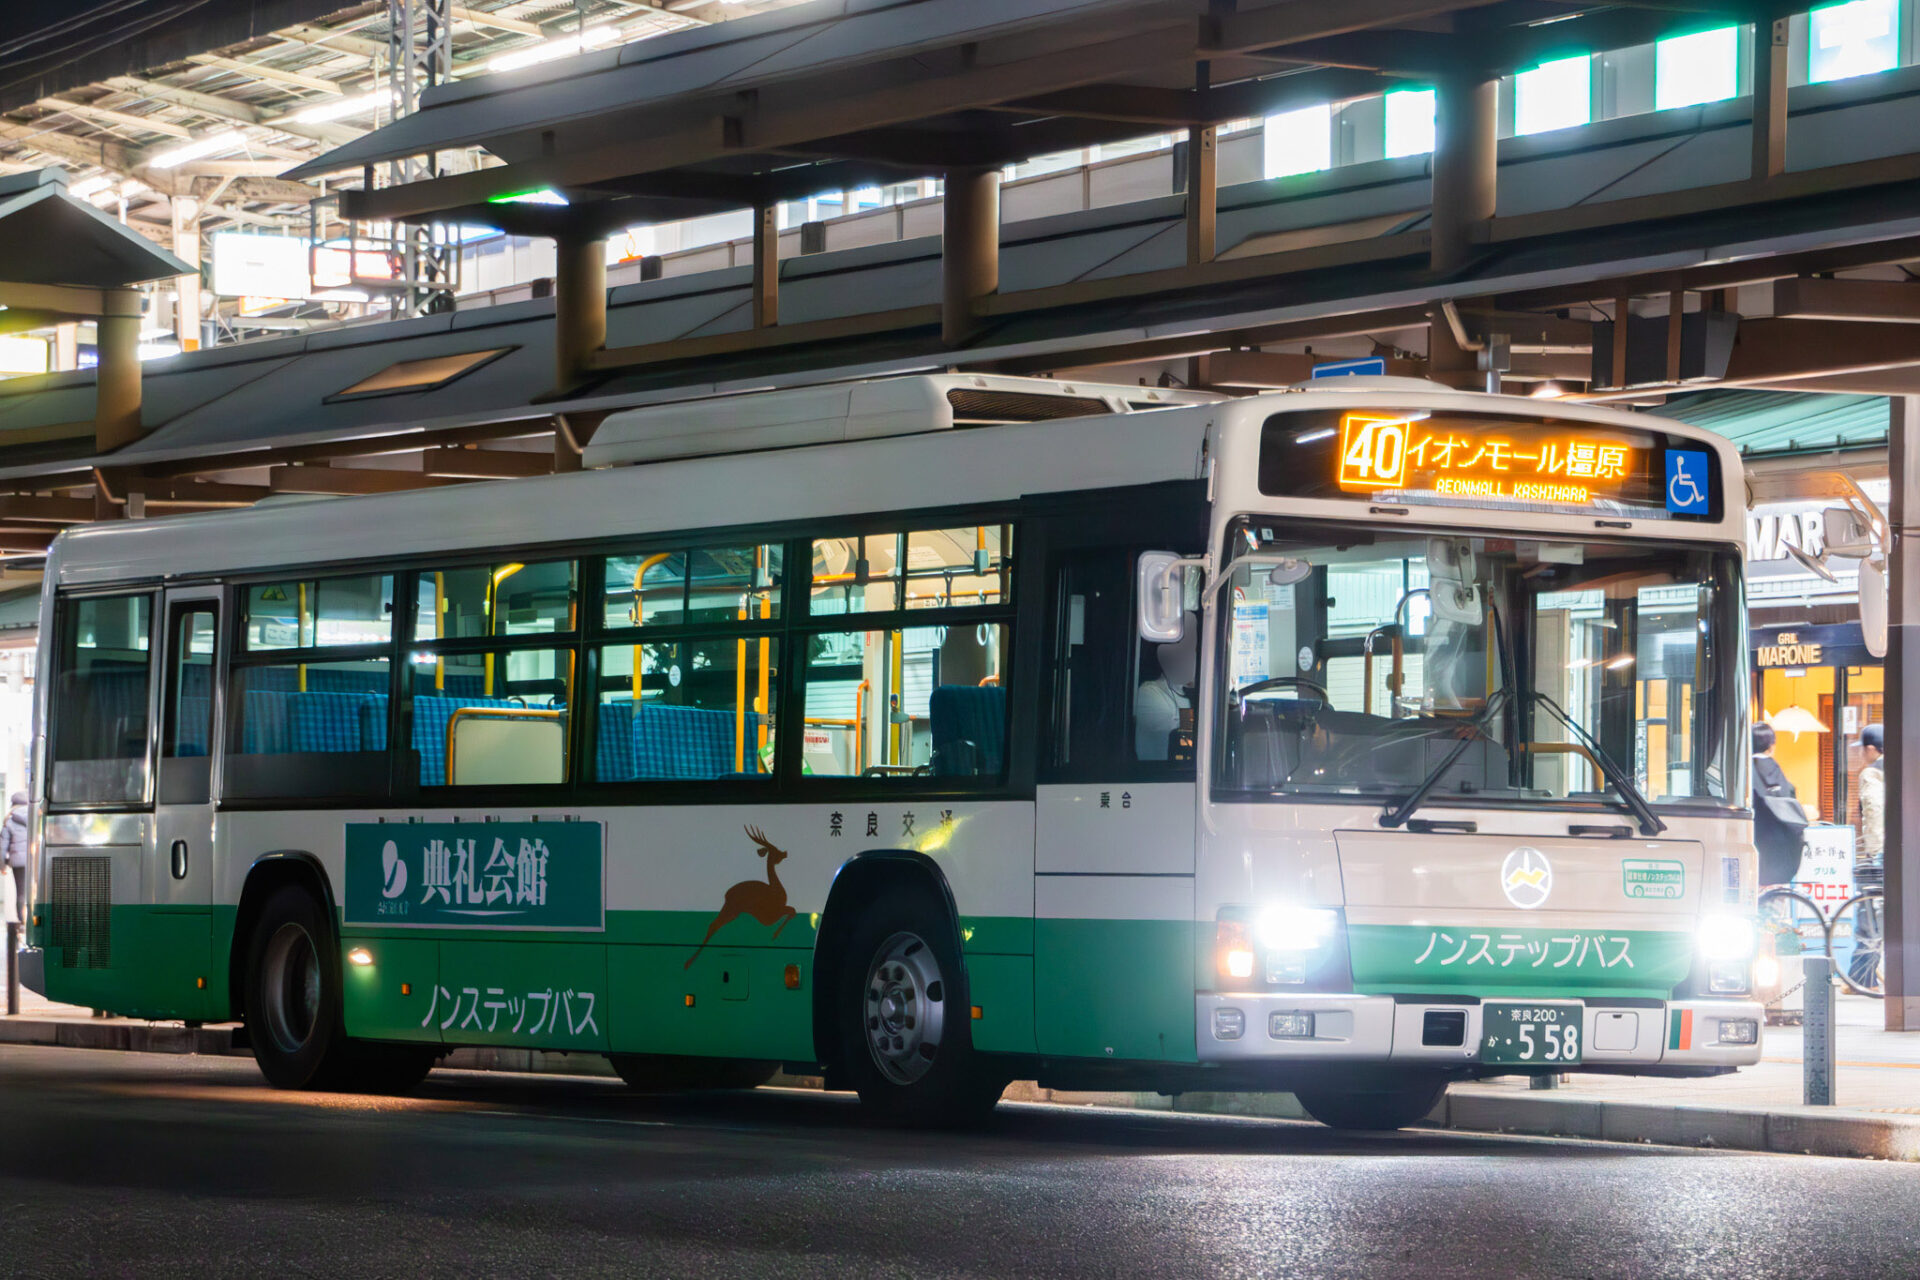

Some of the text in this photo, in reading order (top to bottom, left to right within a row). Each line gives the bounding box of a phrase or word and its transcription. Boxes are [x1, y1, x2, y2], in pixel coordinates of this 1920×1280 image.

[1346, 422, 1628, 478] 40 イオンモール橿原
[1436, 479, 1587, 502] AEONMALL KASHIHARA
[1757, 644, 1822, 667] MARONIE
[420, 837, 550, 906] 典礼会館
[1415, 931, 1634, 968] ノンステップバス
[421, 983, 599, 1036] ノンステップバス
[1511, 1008, 1557, 1022] 奈良200
